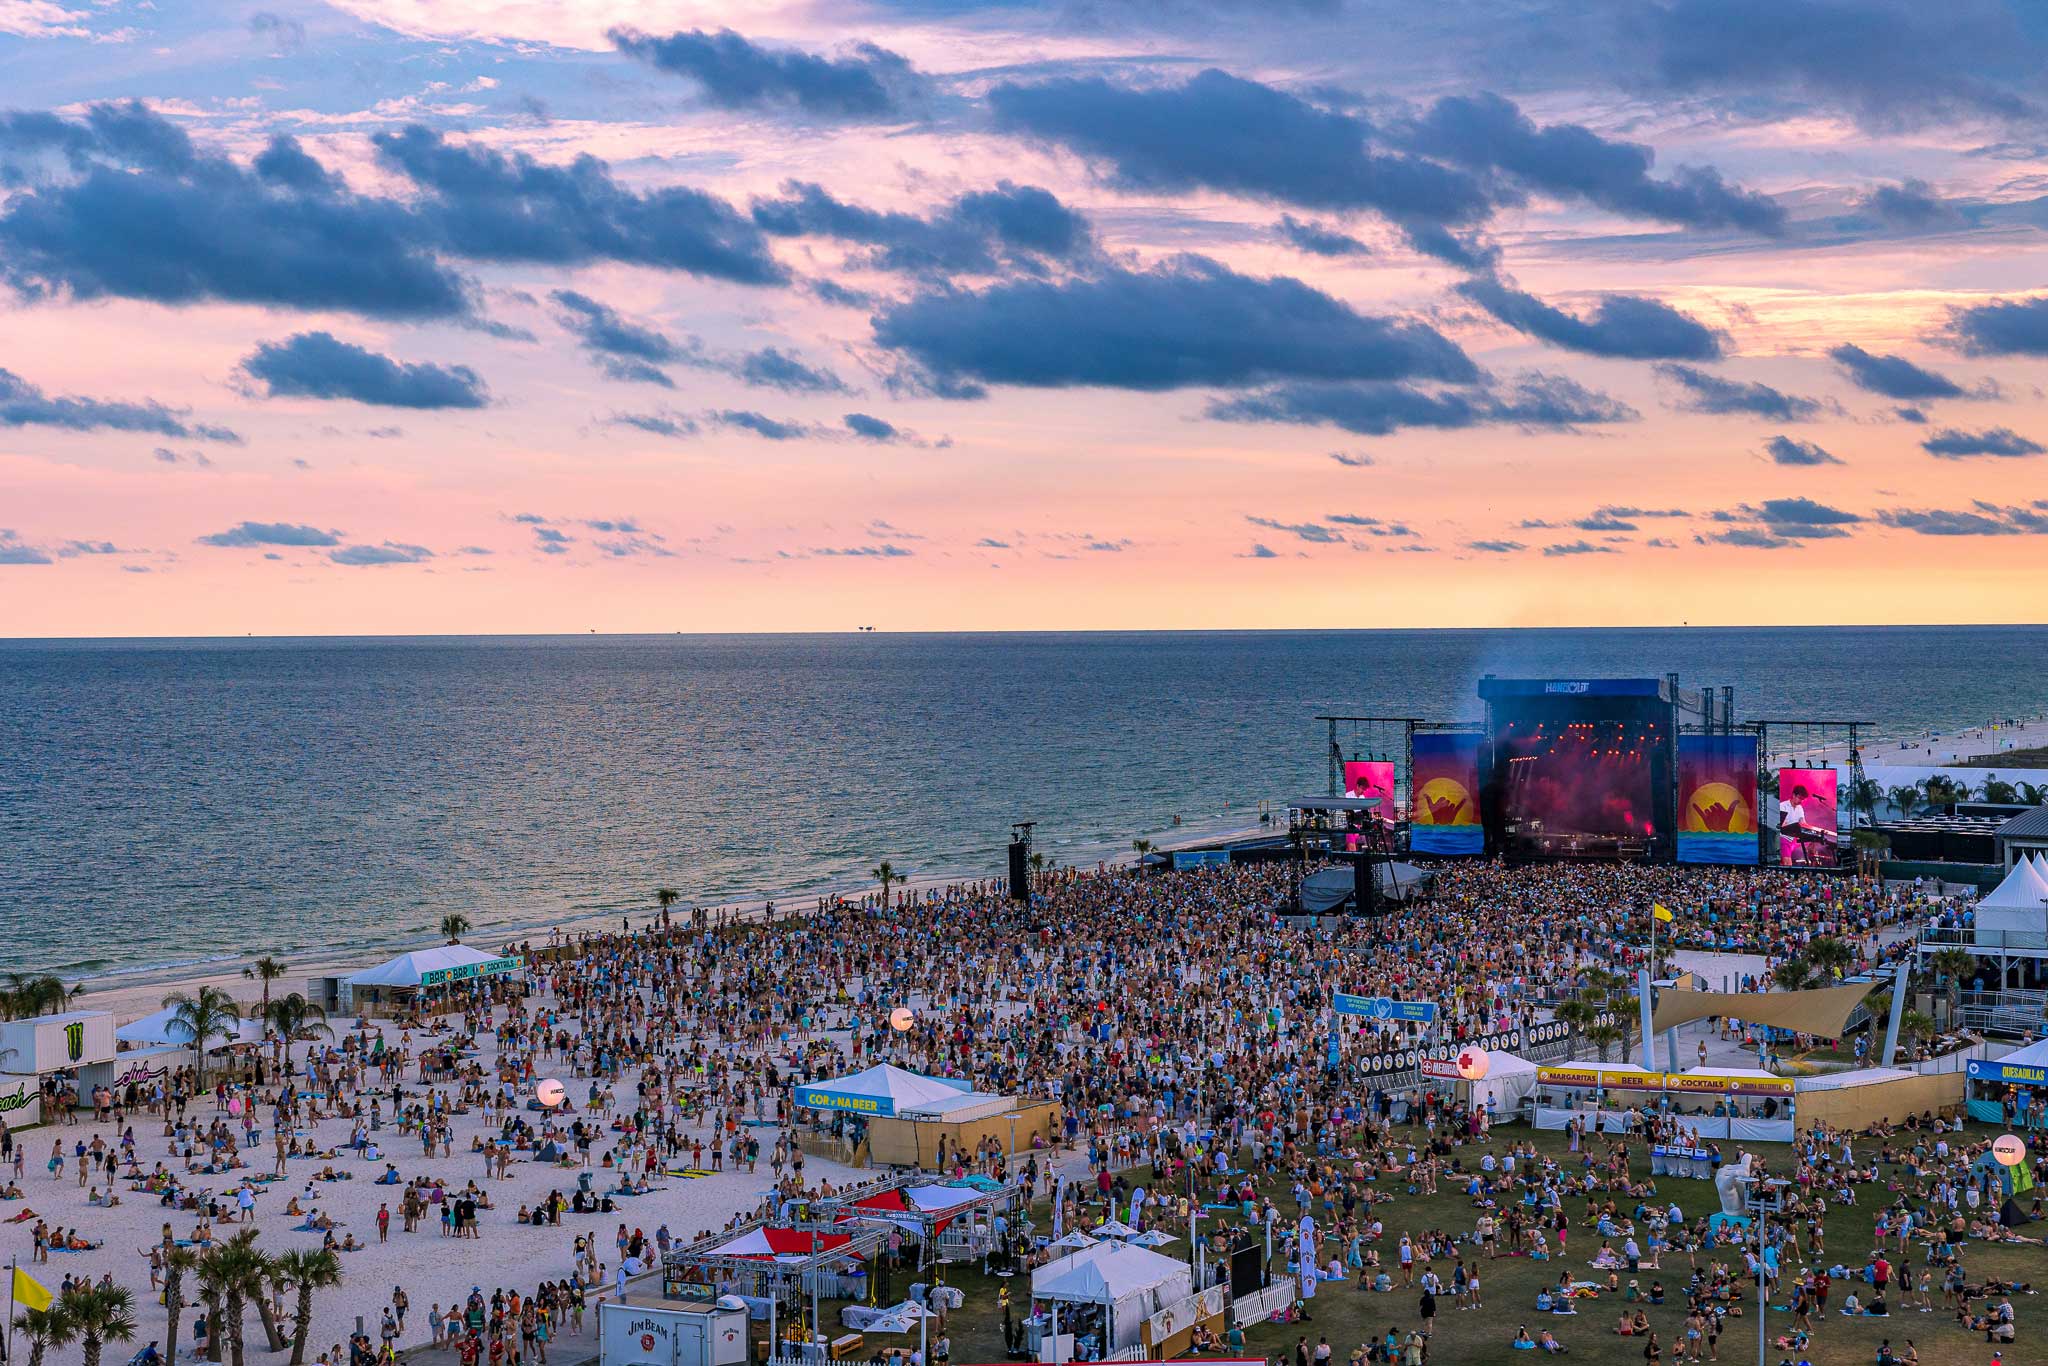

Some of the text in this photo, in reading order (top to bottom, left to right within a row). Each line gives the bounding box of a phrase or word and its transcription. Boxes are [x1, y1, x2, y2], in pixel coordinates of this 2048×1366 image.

[487, 959, 514, 972] COCKTAILS
[429, 967, 468, 985] BAR BAR
[1549, 1073, 1596, 1082] MARGARITAS
[2002, 1066, 2045, 1081] QUESADILLAS
[1621, 1076, 1643, 1085] BEER
[1681, 1079, 1724, 1088] COCKTAILS
[852, 1098, 878, 1112] BEER
[628, 1318, 668, 1340] JIM BEAM
